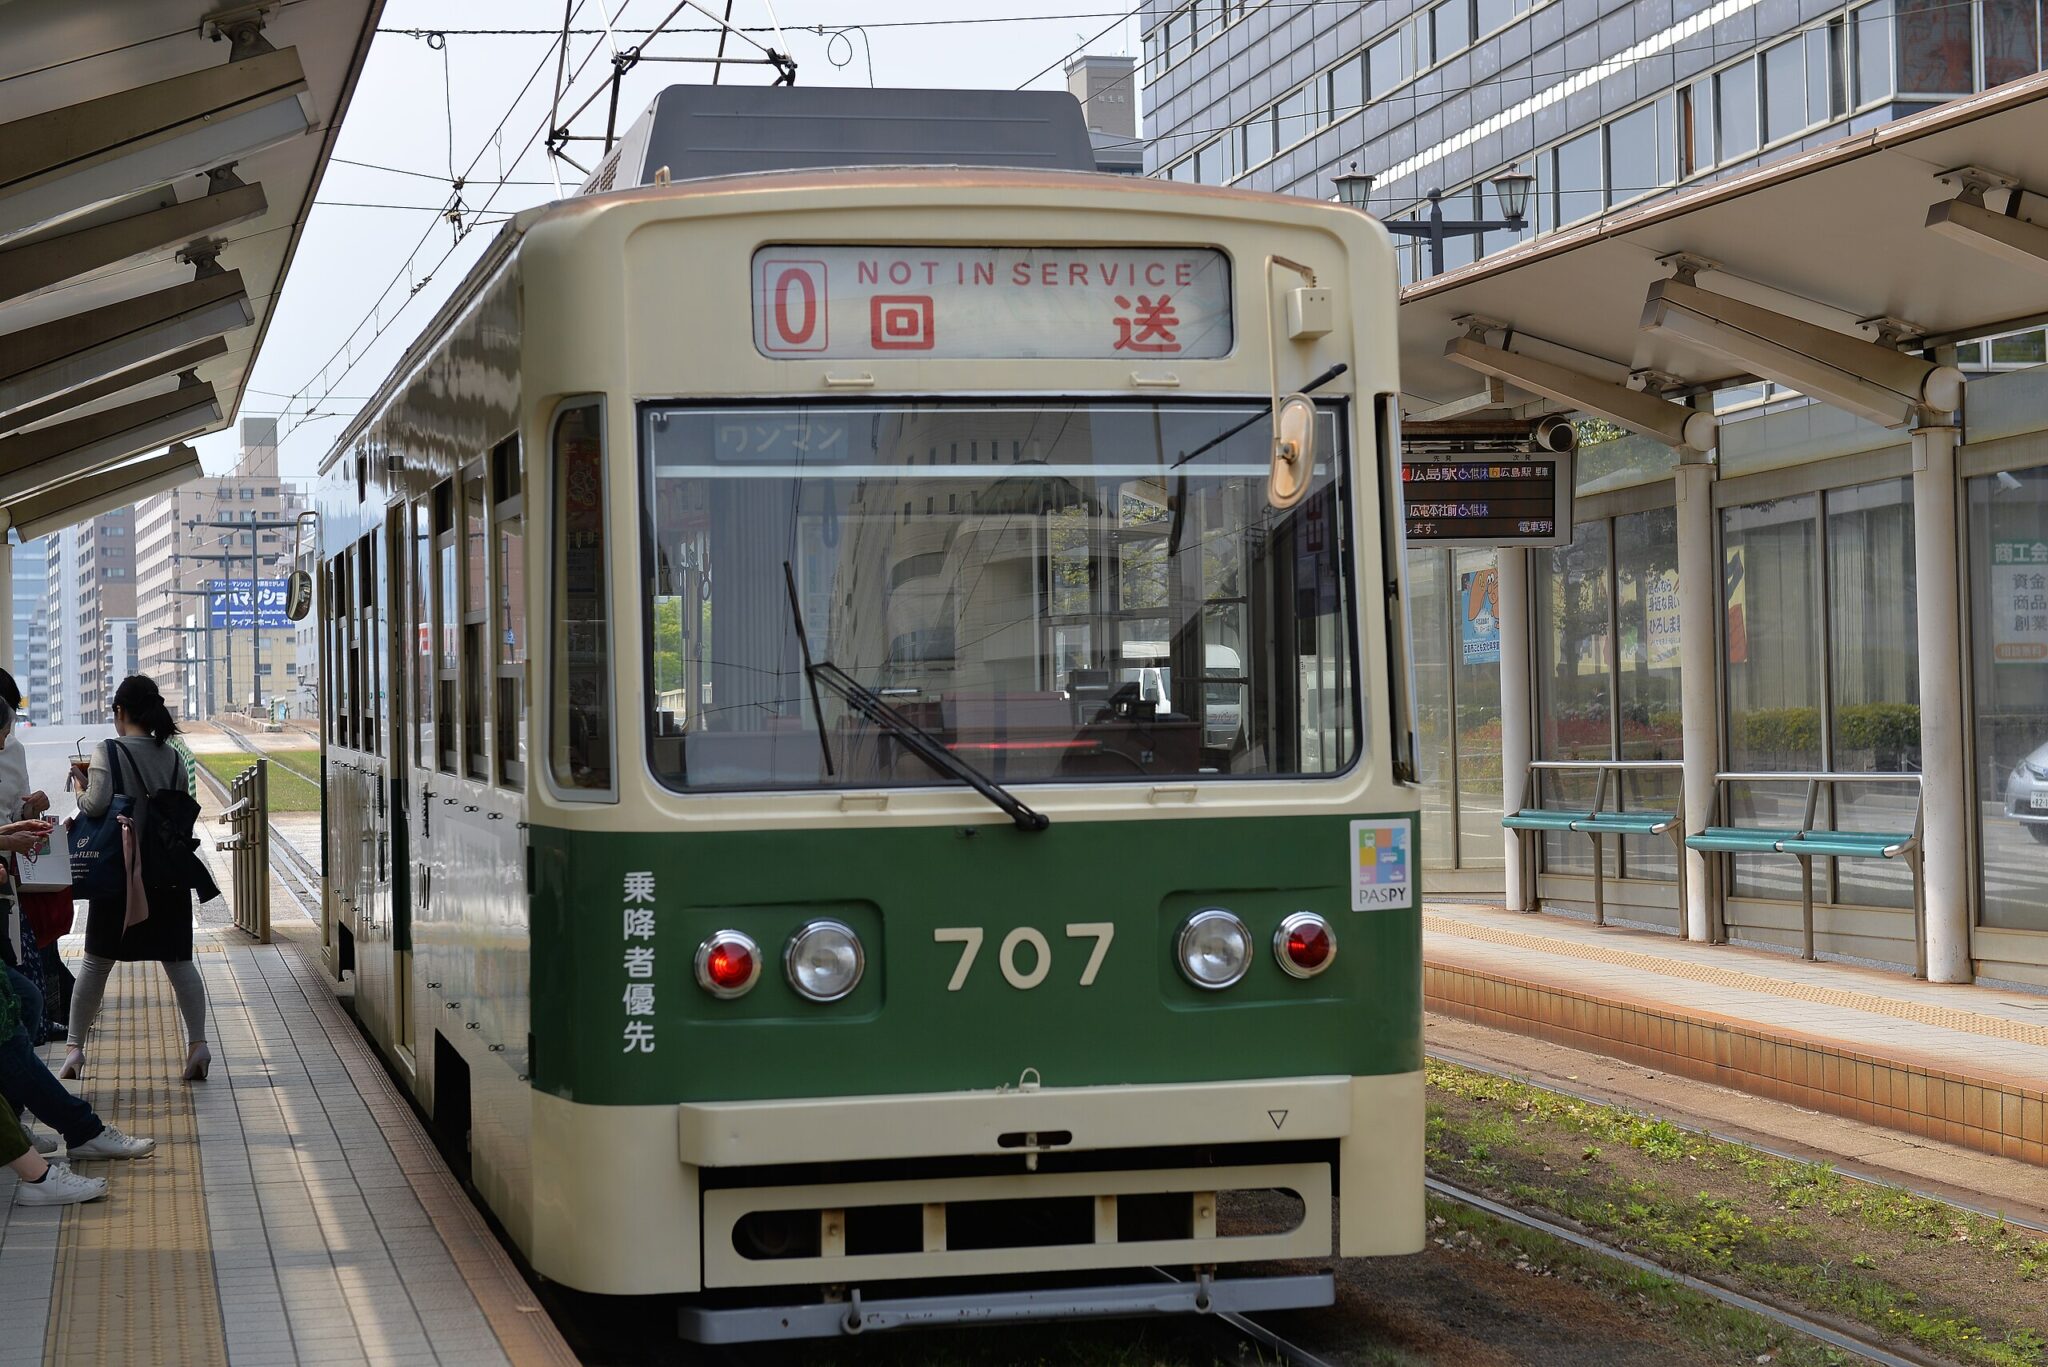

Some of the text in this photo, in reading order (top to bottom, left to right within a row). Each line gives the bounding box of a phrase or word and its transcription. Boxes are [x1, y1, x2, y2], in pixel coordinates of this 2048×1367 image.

[858, 260, 1193, 287] NOT IN SERVICE
[775, 268, 817, 345] 0
[720, 423, 843, 453] ワンマン
[1410, 467, 1458, 481] 広島駅
[1500, 466, 1532, 478] 広島駅
[1409, 504, 1458, 518] 広電本社前
[1995, 542, 2048, 564] 商工会
[2013, 573, 2046, 590] 資金
[2013, 594, 2047, 611] 商品
[2014, 615, 2048, 632] 創業
[1359, 887, 1407, 904] PASPY
[622, 869, 656, 1054] 乗降者優先
[933, 921, 1115, 992] 707
